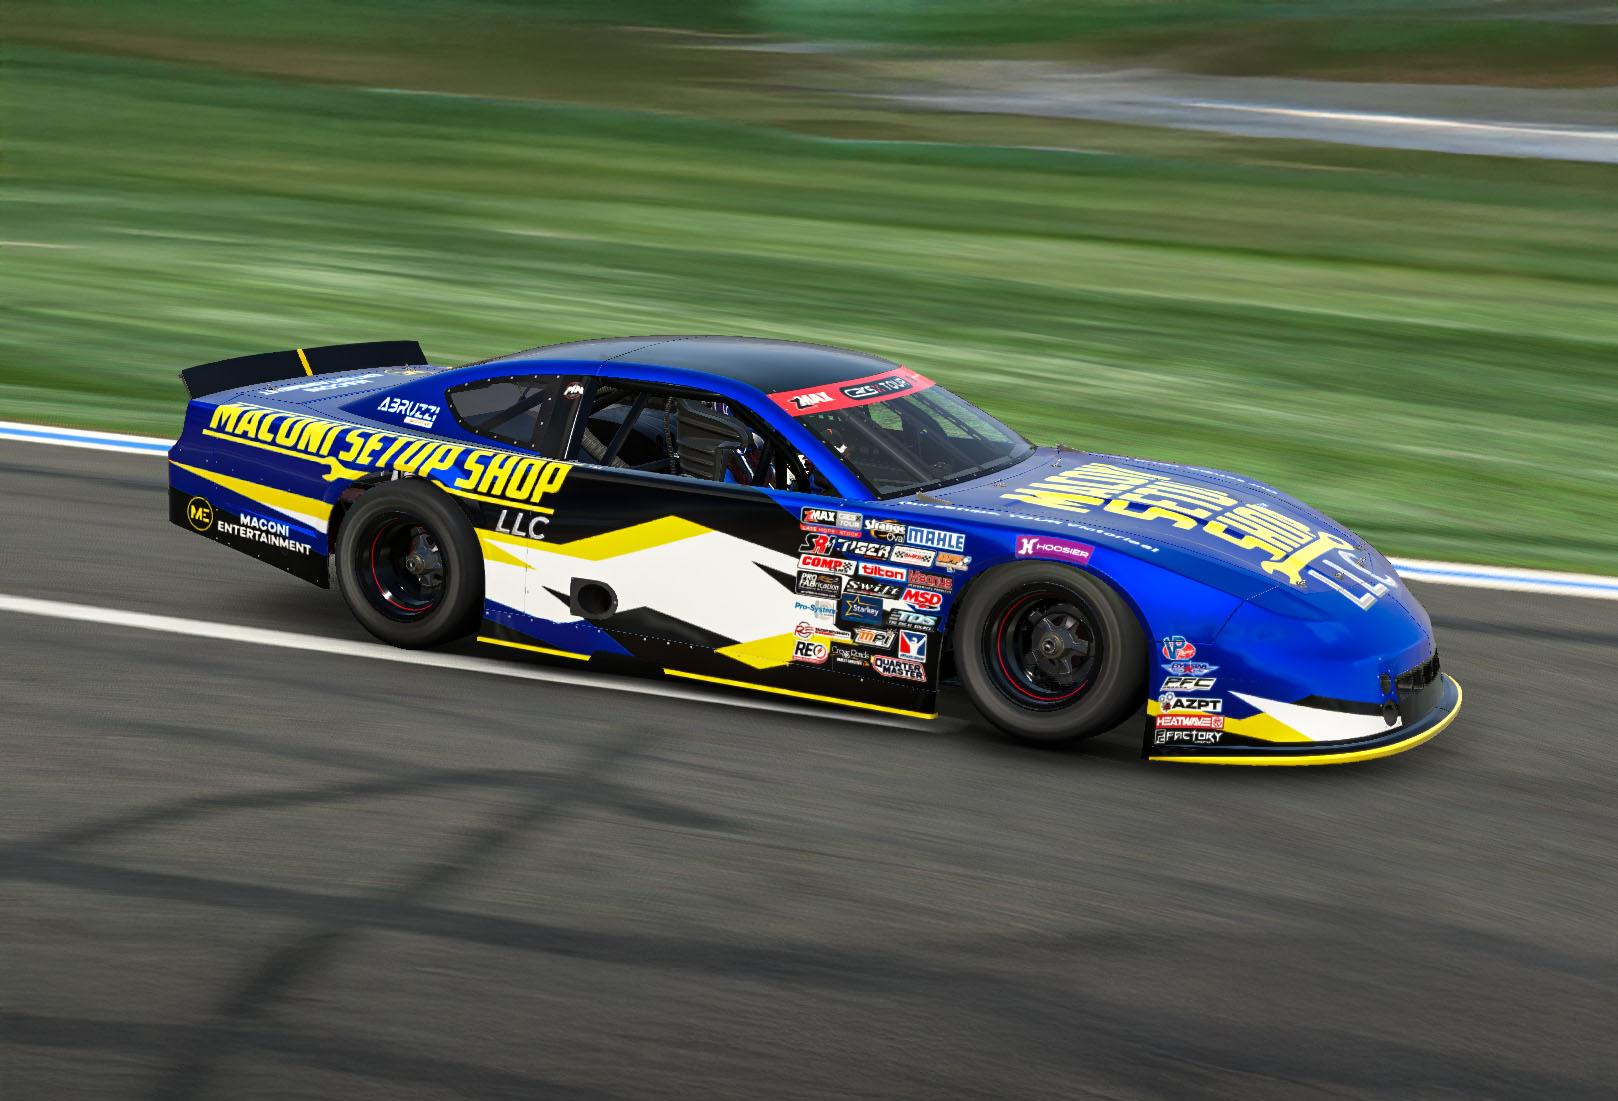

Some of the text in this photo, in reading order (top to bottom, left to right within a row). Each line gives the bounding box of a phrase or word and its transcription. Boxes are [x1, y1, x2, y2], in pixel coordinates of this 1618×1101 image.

[377, 397, 440, 421] ABRUZZI
[209, 404, 573, 502] MACONI SETUP SHOP
[191, 505, 209, 522] ME
[240, 513, 289, 537] MACONI
[495, 509, 550, 539] LLC
[217, 521, 311, 555] ENTERTAINMENT
[908, 527, 963, 550] MAHLE
[838, 538, 891, 558] TIGER
[1037, 543, 1089, 559] HOOSIER
[802, 556, 843, 569] COMP
[801, 572, 818, 582] PRO
[862, 564, 904, 580] tilton
[1308, 550, 1397, 611] LLC
[903, 589, 942, 605] MSD
[853, 604, 879, 617] Starkey
[1163, 636, 1187, 660] VP
[875, 657, 921, 672] QUARTER
[883, 665, 923, 679] MASTER
[1172, 698, 1221, 711] AZPT
[1157, 716, 1211, 727] HEATWAVE
